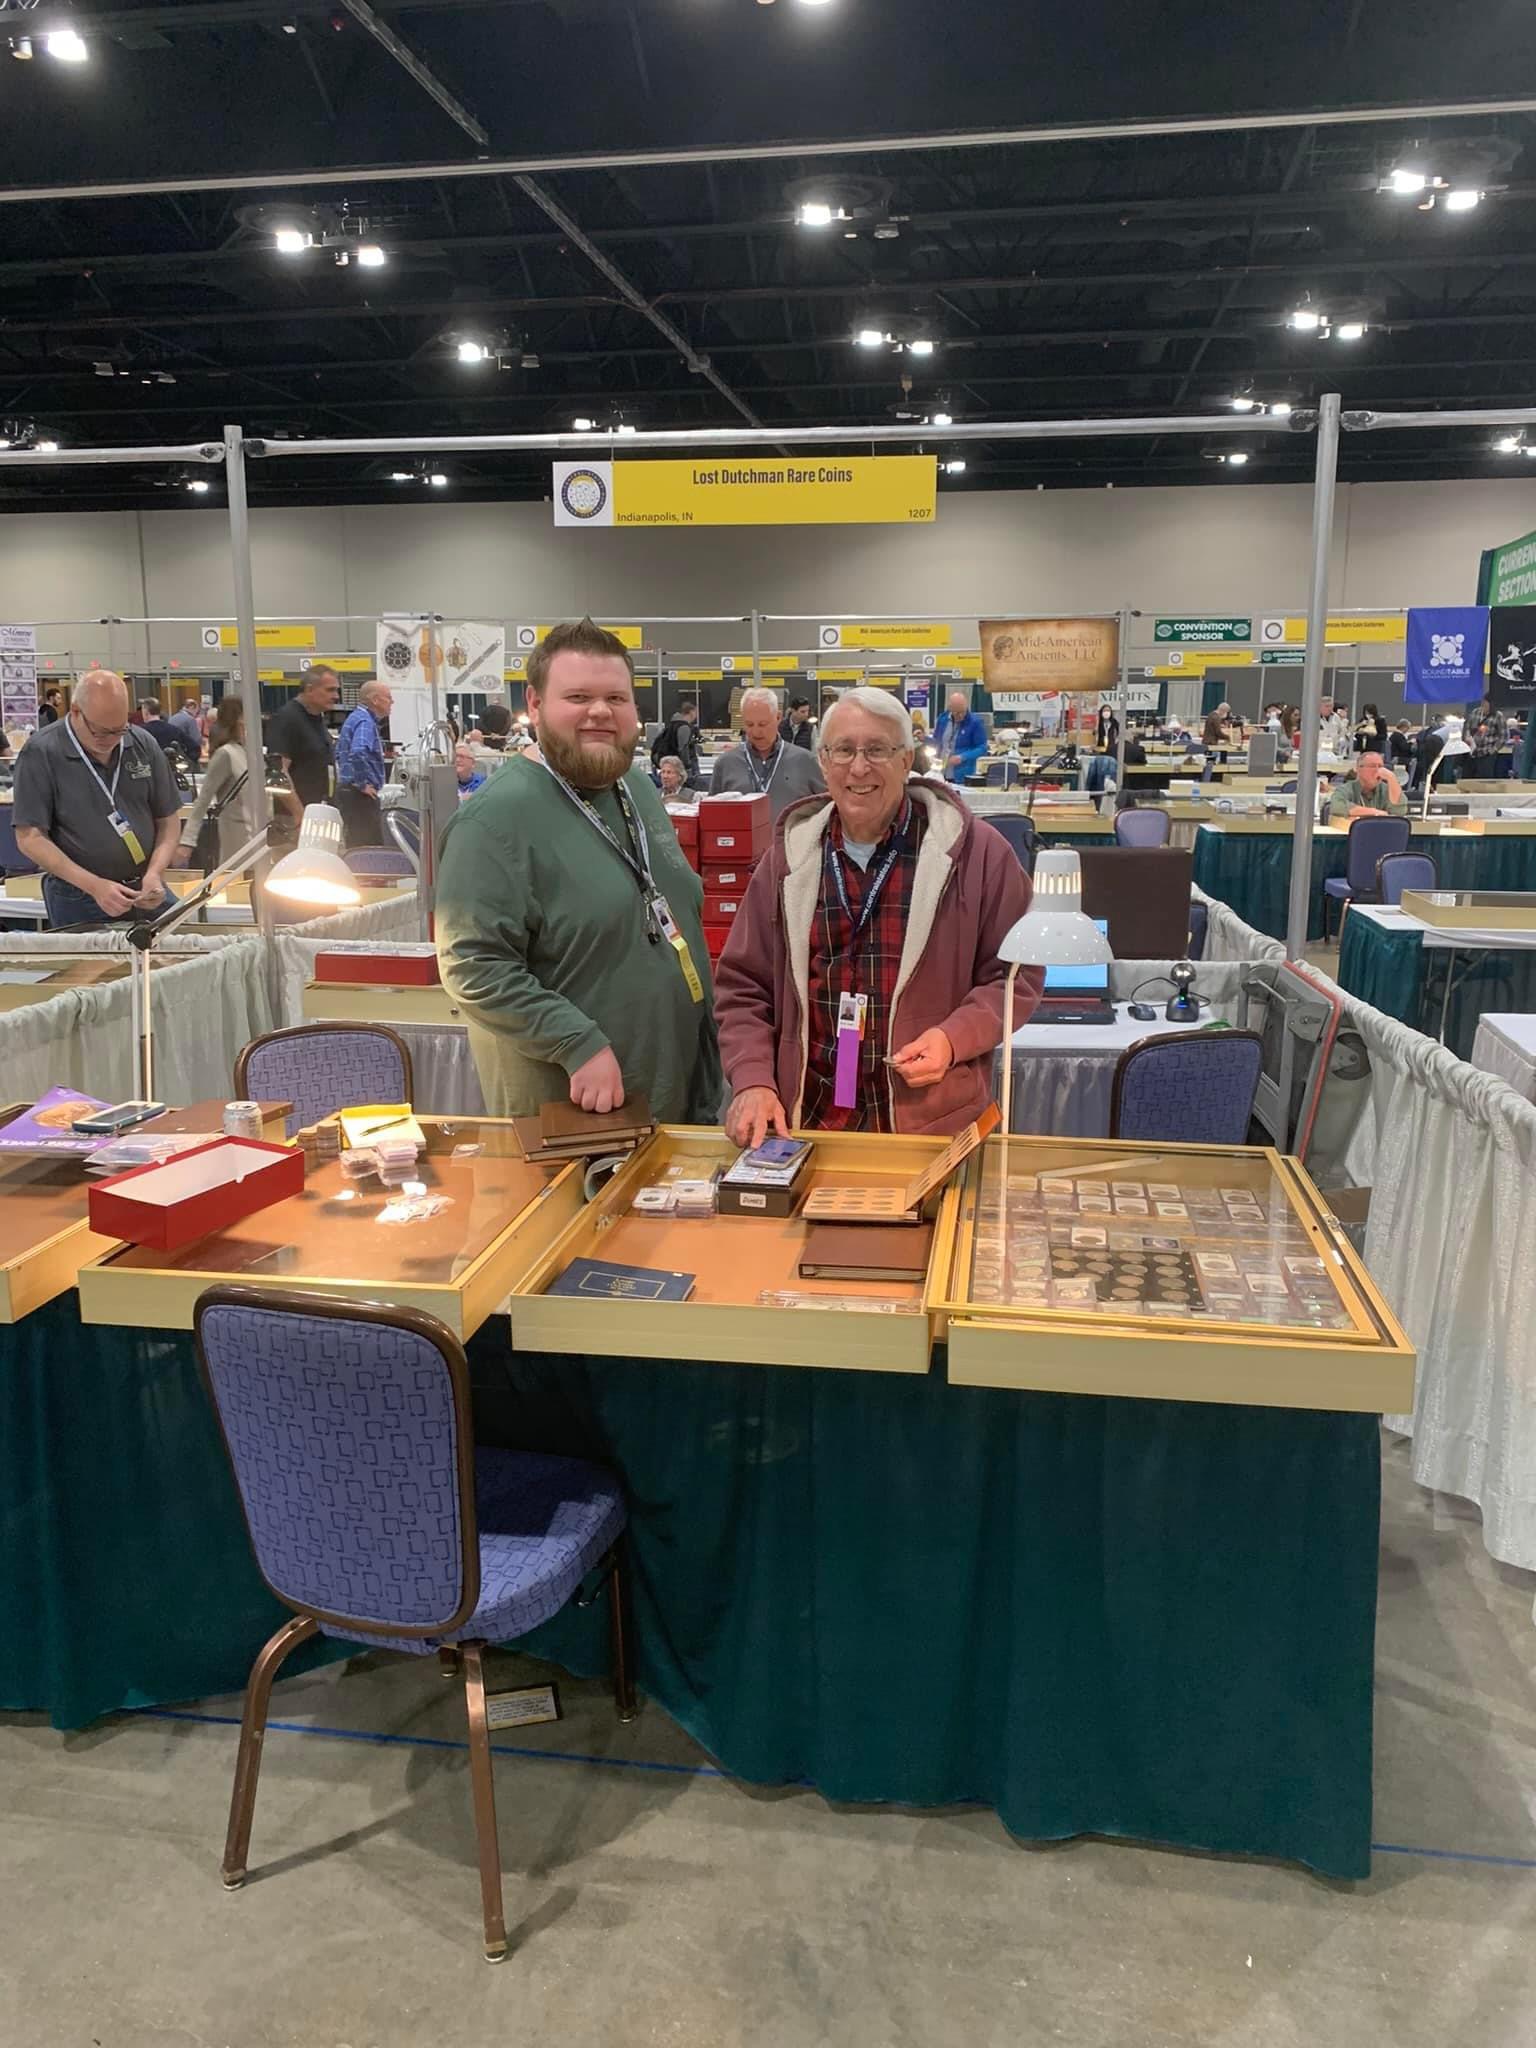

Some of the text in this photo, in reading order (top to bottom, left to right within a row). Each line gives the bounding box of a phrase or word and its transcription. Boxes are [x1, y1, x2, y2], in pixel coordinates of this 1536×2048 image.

[693, 466, 853, 485] Lost Dutchman Rare Coins
[617, 512, 694, 522] Indianapolis, IN
[908, 509, 931, 518] 1207
[1173, 623, 1233, 632] CONVENTION
[1180, 632, 1224, 640] SPONSOR
[1017, 635, 1103, 648] Mid-American
[859, 849, 897, 927] www.centralstates.info
